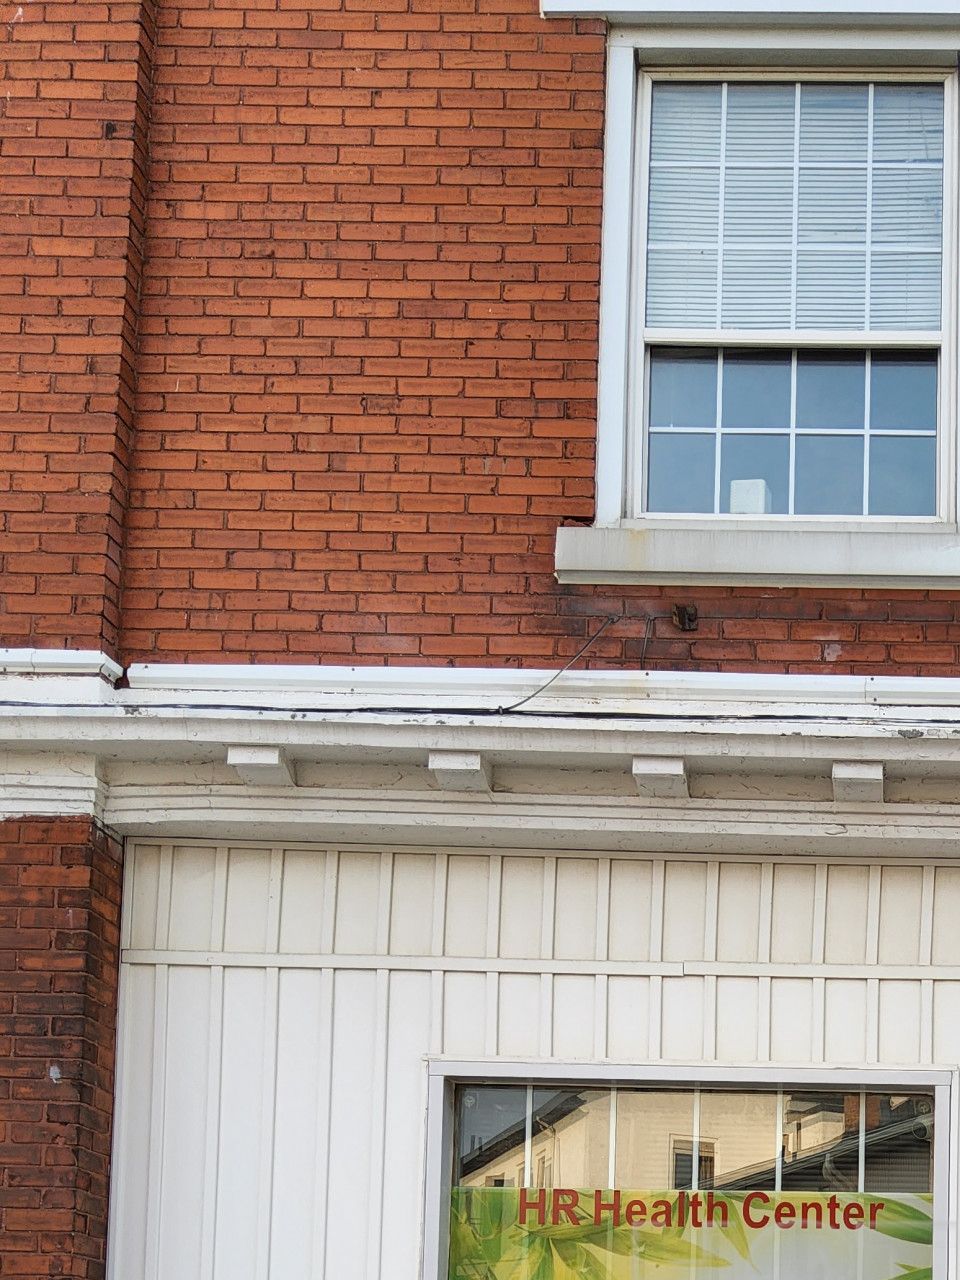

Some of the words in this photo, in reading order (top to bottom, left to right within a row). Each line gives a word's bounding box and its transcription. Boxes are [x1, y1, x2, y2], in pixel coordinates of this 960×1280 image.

[518, 1187, 581, 1226] HR
[592, 1188, 730, 1229] Health
[741, 1190, 884, 1231] Center
